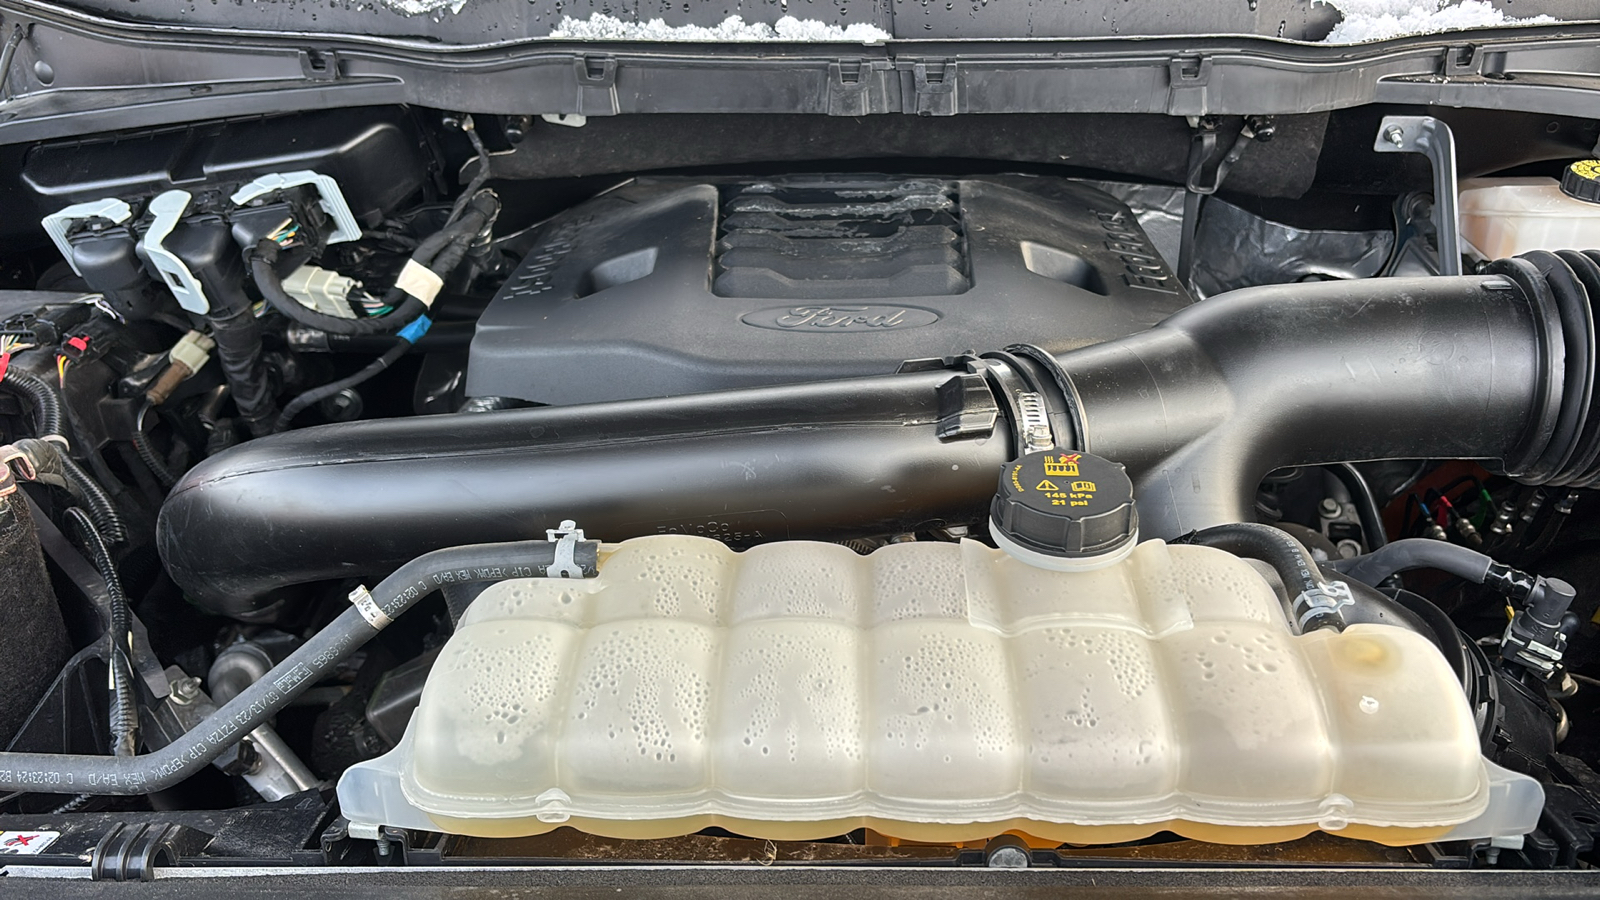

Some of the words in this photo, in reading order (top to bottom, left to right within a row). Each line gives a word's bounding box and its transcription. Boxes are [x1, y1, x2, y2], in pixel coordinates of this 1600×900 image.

[776, 305, 906, 328] Ford
[1045, 492, 1067, 500] 145
[1070, 500, 1088, 508] psi
[455, 569, 472, 582] MEX
[189, 742, 207, 760] CIP
[16, 770, 60, 784] 02:23:24
[123, 771, 147, 785] MEX
